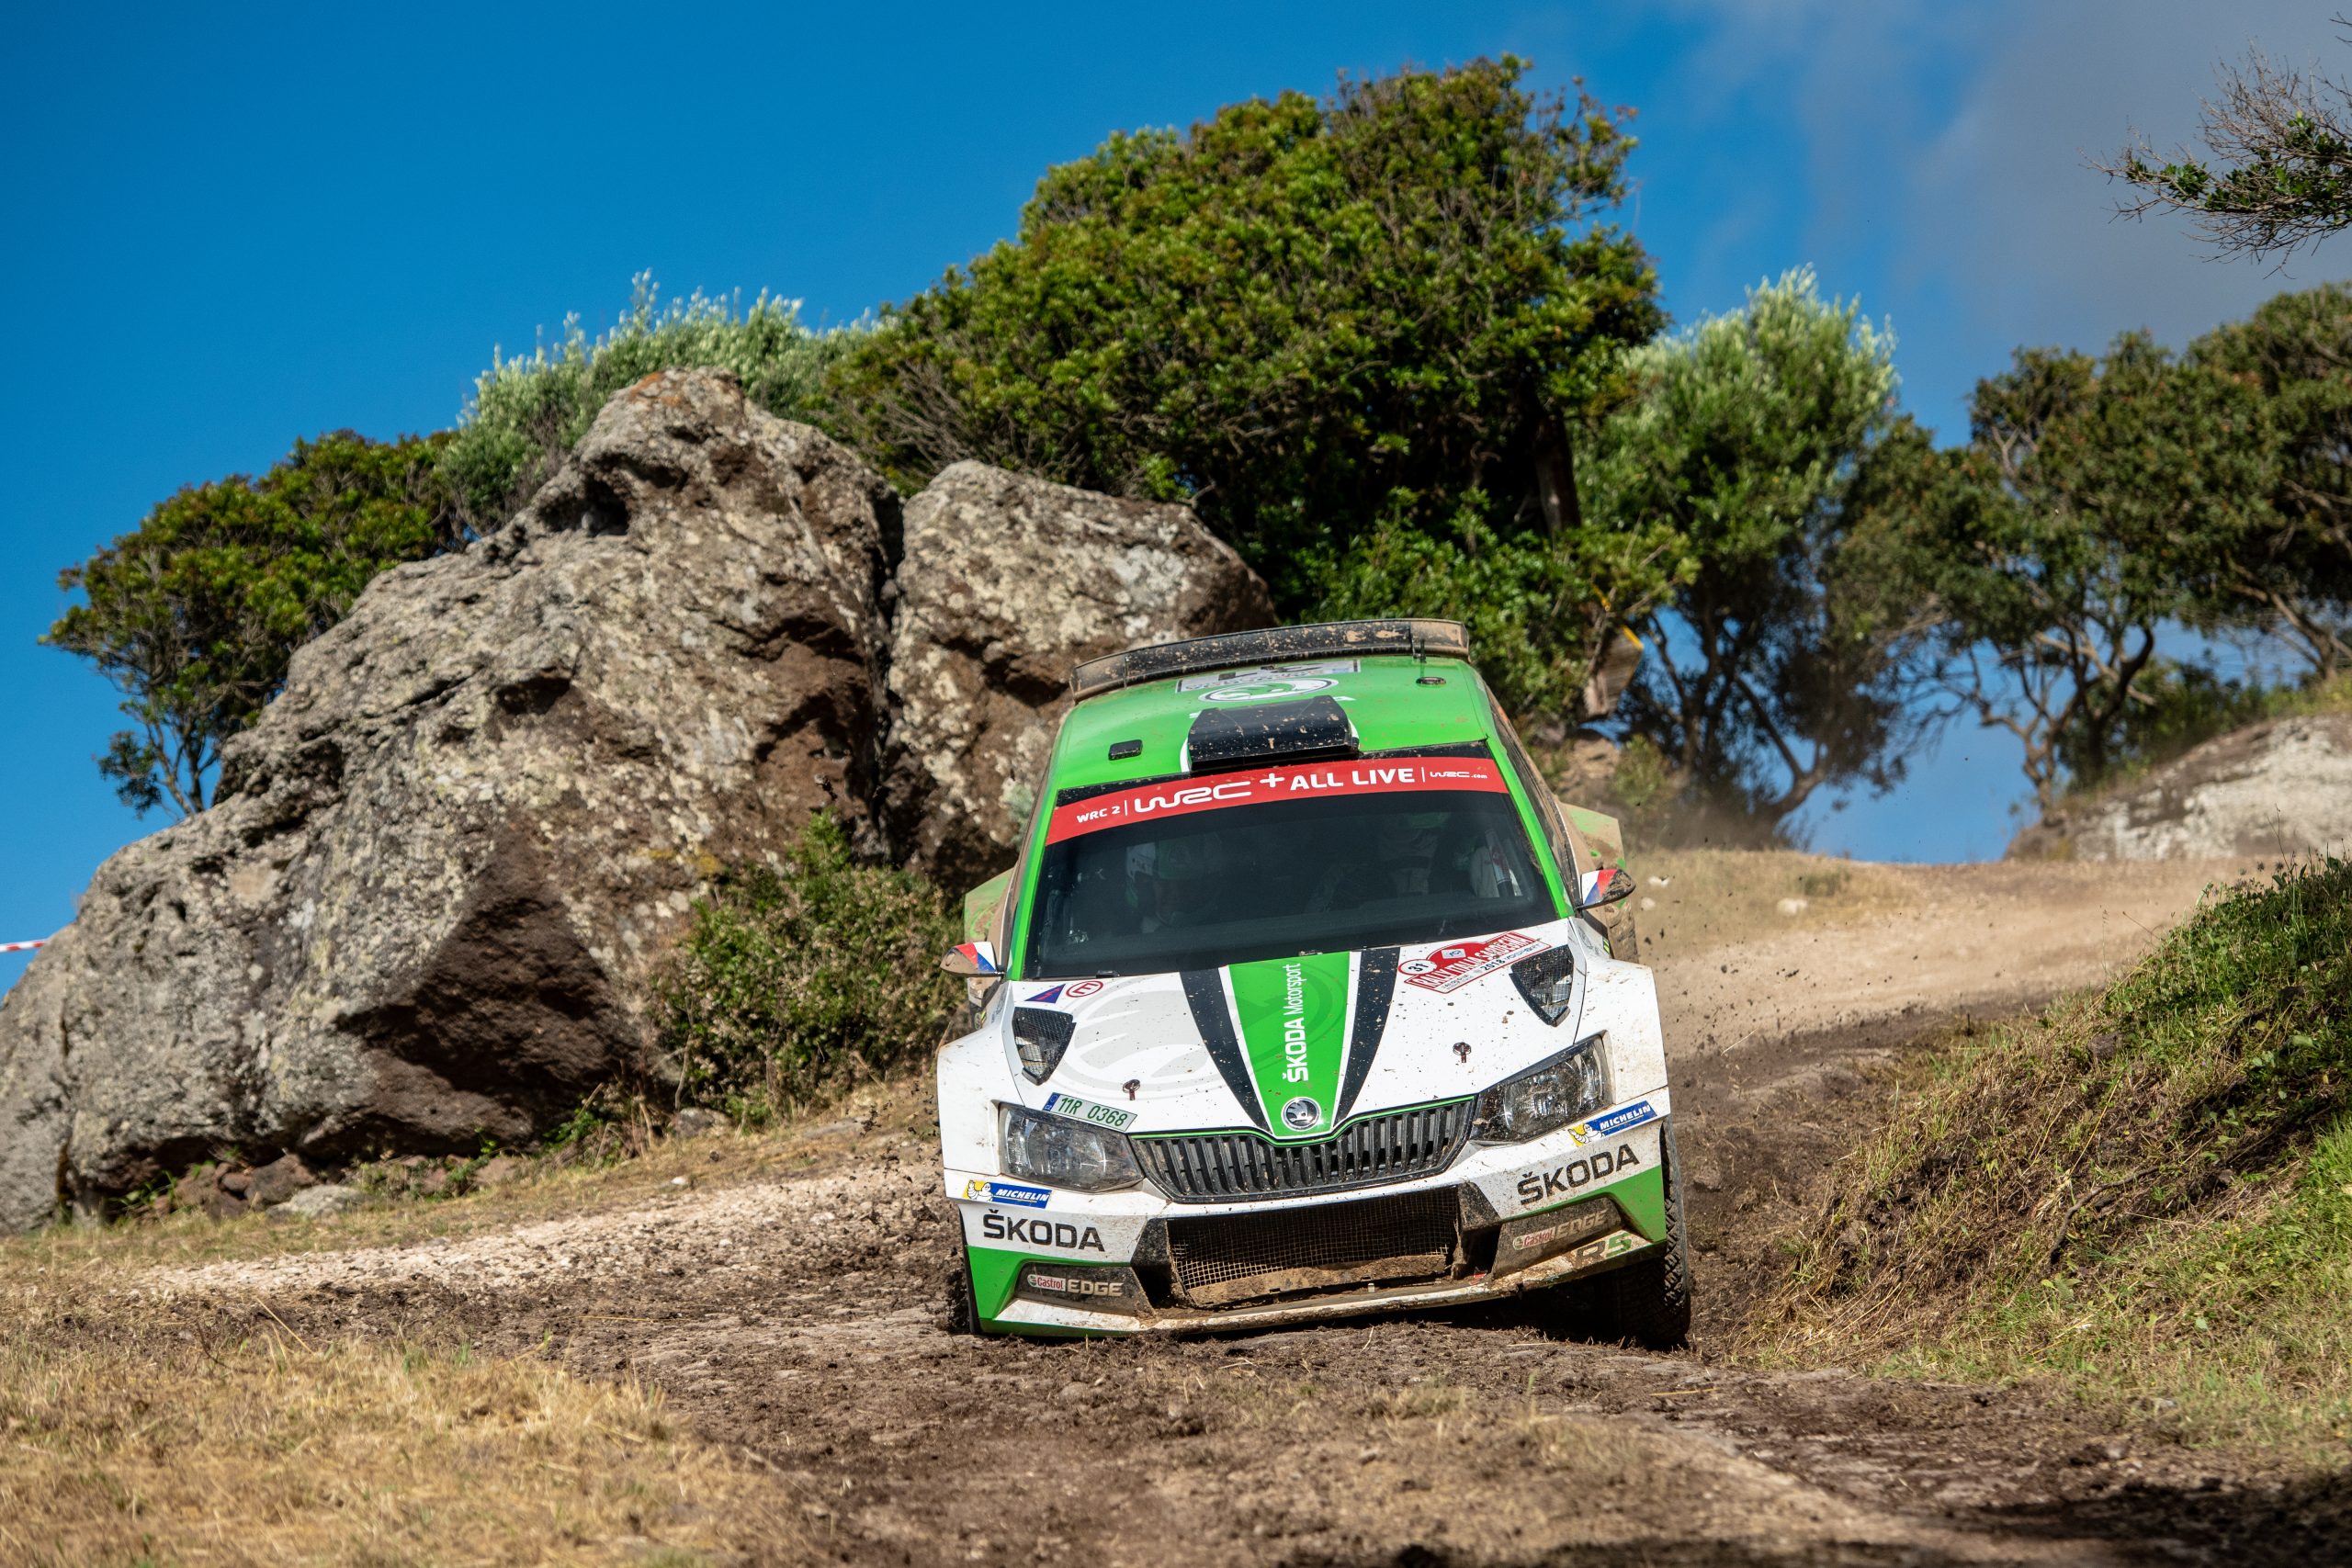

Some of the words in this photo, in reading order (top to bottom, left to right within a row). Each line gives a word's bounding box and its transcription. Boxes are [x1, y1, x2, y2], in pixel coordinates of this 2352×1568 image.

[1290, 773, 1344, 791] ALL
[1351, 768, 1415, 785] LIVE
[1076, 808, 1108, 823] WRC
[1111, 806, 1121, 816] 2
[1408, 963, 1430, 972] 31
[1411, 968, 1455, 987] RALLY
[1444, 956, 1488, 975] ITALIA
[1479, 958, 1507, 971] 2018
[1283, 963, 1307, 1015] Motorsport
[1282, 1017, 1309, 1083] ŠKODA
[1087, 1105, 1128, 1127] 0368
[1600, 1104, 1651, 1130] MICHELIN
[1517, 1144, 1640, 1205] ŠKODA
[995, 1188, 1050, 1201] MICHELIN
[983, 1209, 1105, 1252] ŠKODA
[1522, 1228, 1555, 1247] Castrol
[1037, 1277, 1064, 1290] Castrol
[1068, 1279, 1124, 1296] EDGE
